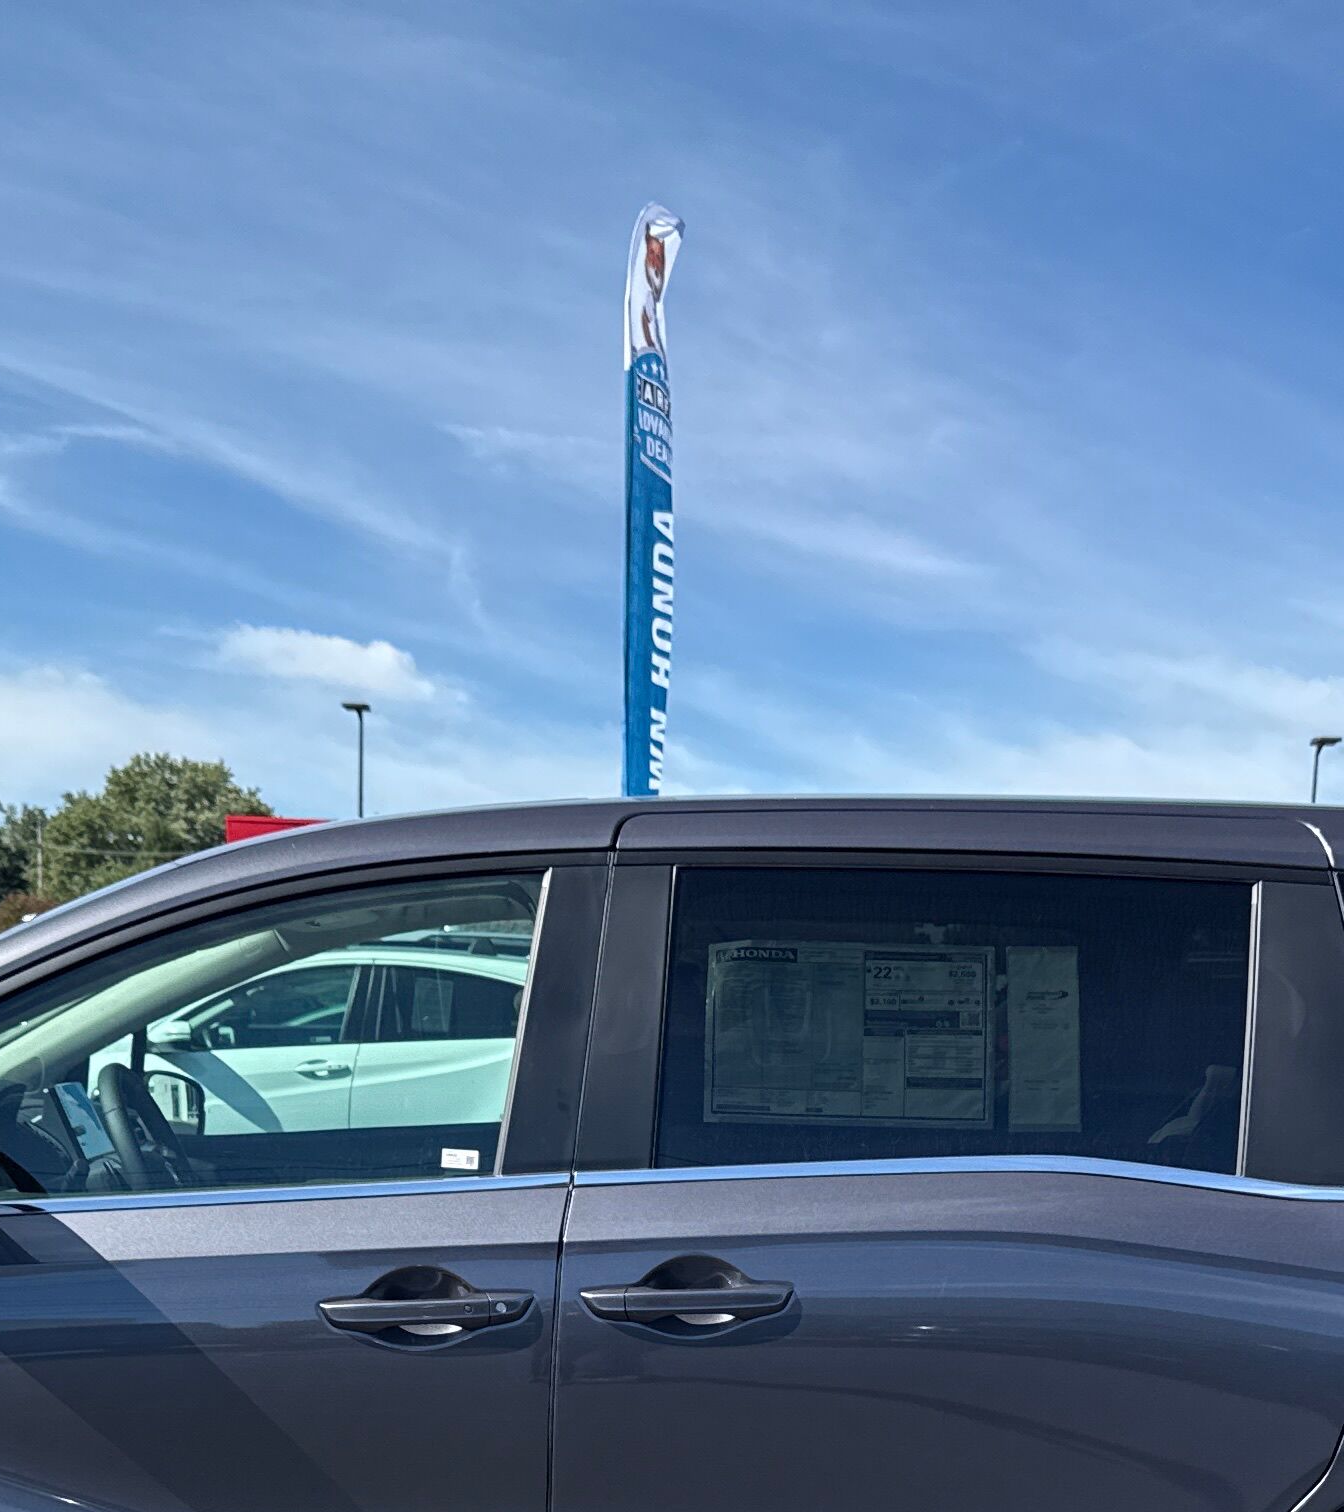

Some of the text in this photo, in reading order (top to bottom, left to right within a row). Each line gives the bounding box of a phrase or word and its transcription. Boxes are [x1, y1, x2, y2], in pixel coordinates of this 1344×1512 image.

[650, 511, 675, 690] HONDA
[730, 948, 795, 960] HONDA
[872, 966, 893, 979] 22
